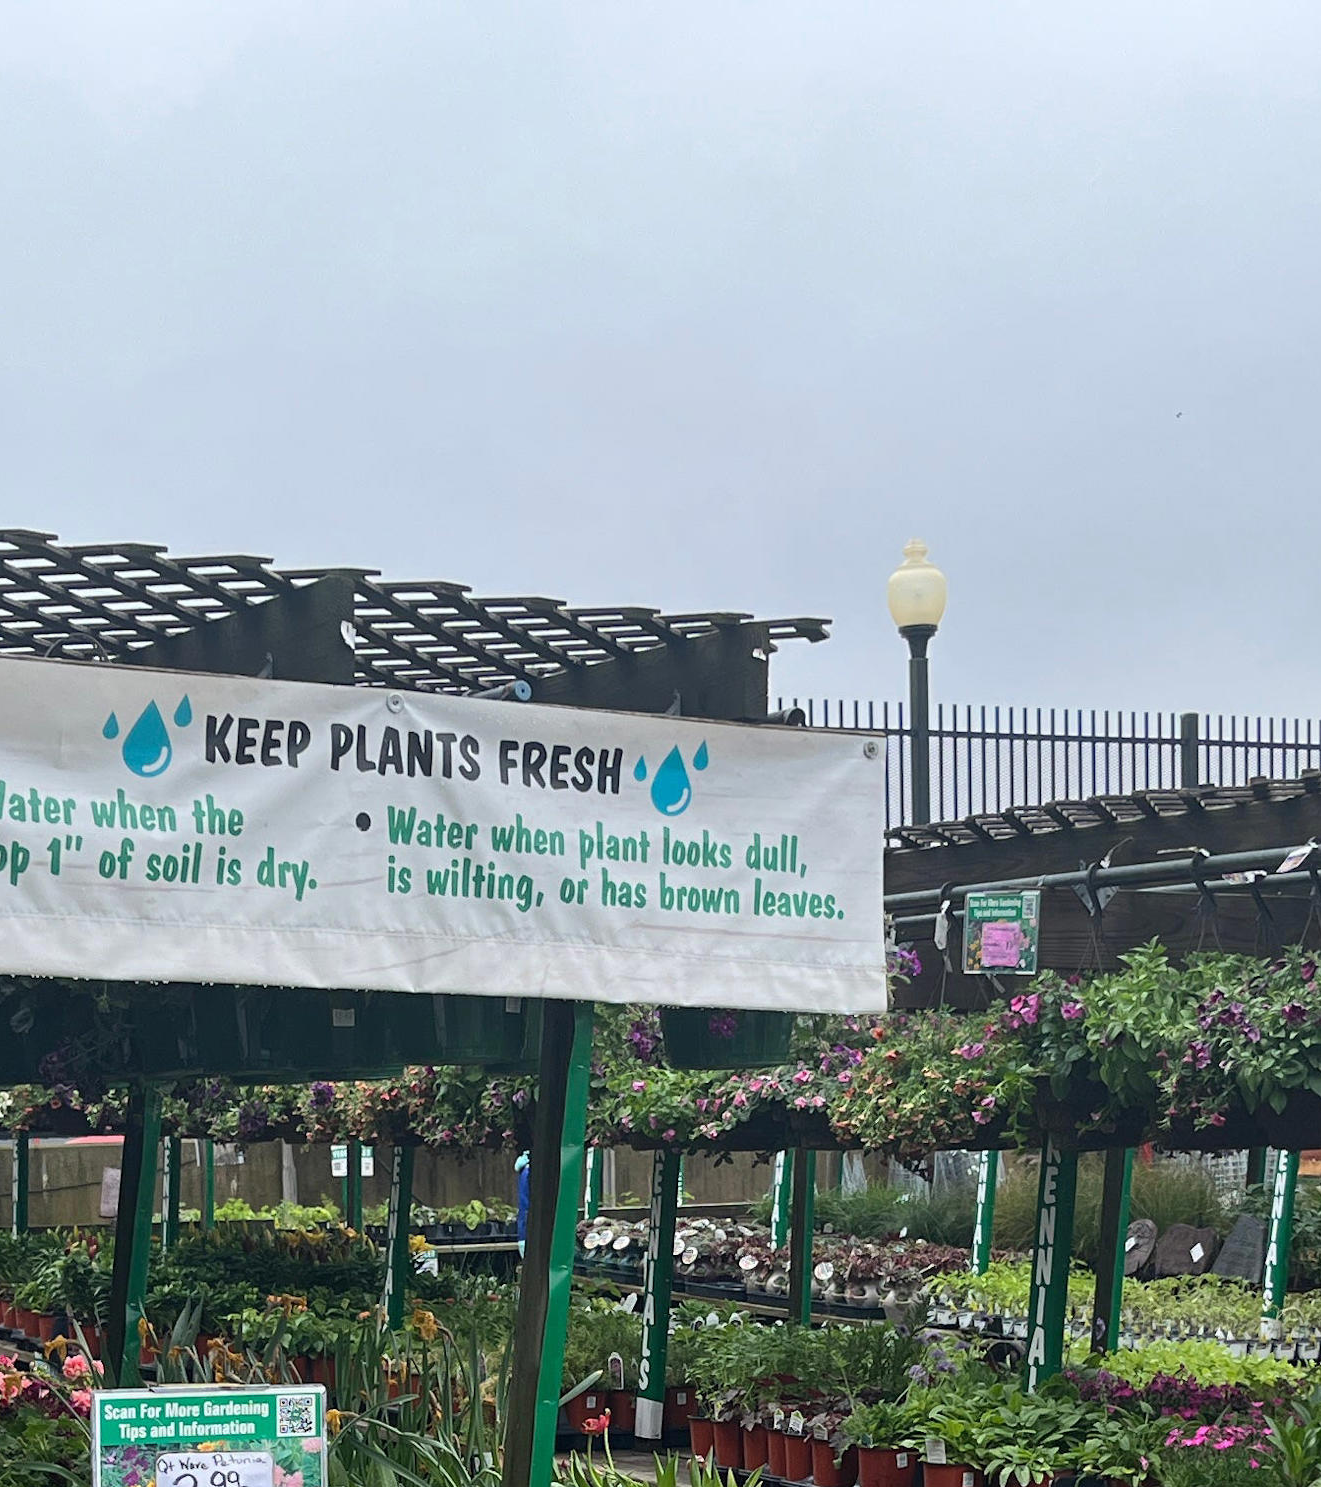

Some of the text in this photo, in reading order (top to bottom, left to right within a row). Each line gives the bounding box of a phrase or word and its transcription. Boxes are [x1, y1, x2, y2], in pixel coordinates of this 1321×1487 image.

[205, 713, 623, 795] KEEP PLANTS FRESH
[91, 789, 177, 832] when
[192, 794, 244, 836] the
[387, 805, 808, 878] Water when plant looks dull,
[47, 835, 83, 876] 1"
[99, 838, 134, 881] of
[146, 843, 202, 884] soil
[216, 846, 241, 886] is
[257, 847, 318, 901] dry.
[387, 855, 844, 920] is wilting, or has brown leaves.
[104, 1400, 269, 1421] Scan For More Gardening
[118, 1420, 255, 1442] Tips and Information
